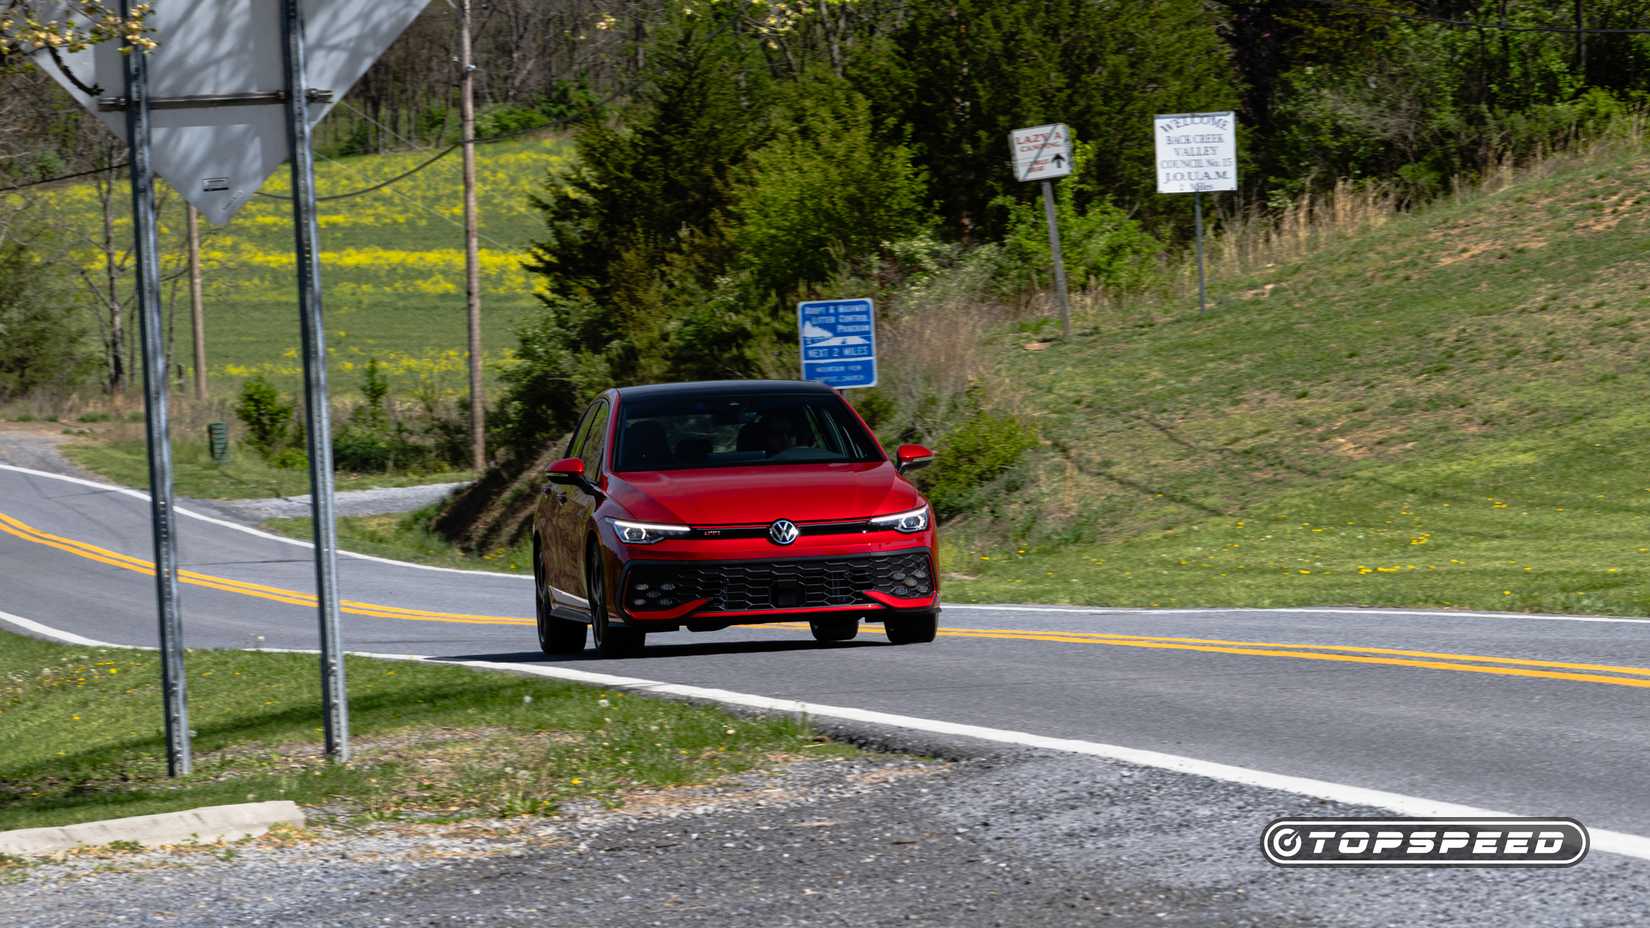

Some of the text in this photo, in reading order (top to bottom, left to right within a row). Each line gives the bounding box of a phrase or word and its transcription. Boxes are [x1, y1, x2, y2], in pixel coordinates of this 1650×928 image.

[1159, 117, 1228, 132] WELCOME
[1165, 134, 1224, 145] BACK CREEK
[1174, 146, 1218, 156] VALLEY
[1160, 159, 1206, 169] COUNCIL
[808, 346, 868, 358] NEXT 2 MILES
